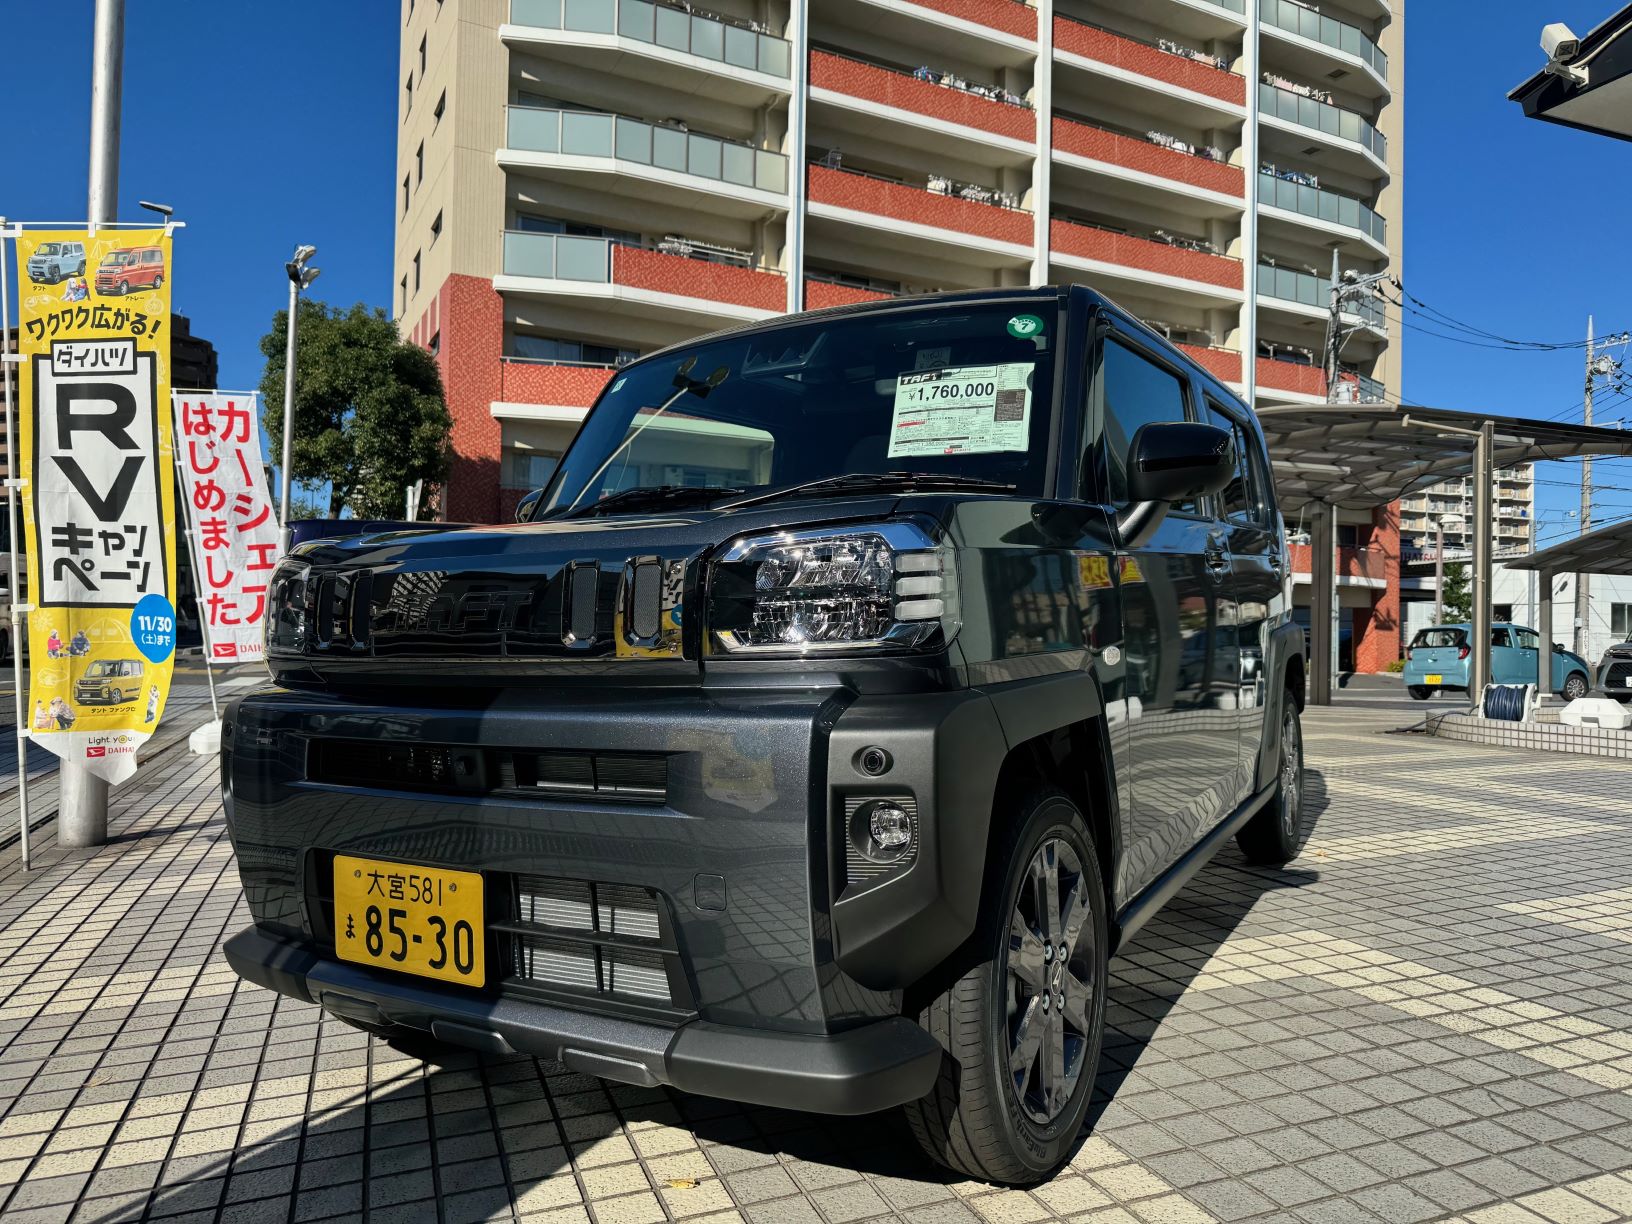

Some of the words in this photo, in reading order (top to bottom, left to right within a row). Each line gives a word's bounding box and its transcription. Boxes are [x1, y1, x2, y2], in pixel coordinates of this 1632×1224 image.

[56, 345, 128, 368] ダイハツ
[182, 402, 241, 626] はじめました
[51, 523, 148, 557] キャン
[53, 557, 151, 592] ペーン
[138, 615, 172, 632] 11/30
[88, 736, 110, 745] Light
[345, 913, 356, 939] ま
[365, 905, 474, 975] 85-30
